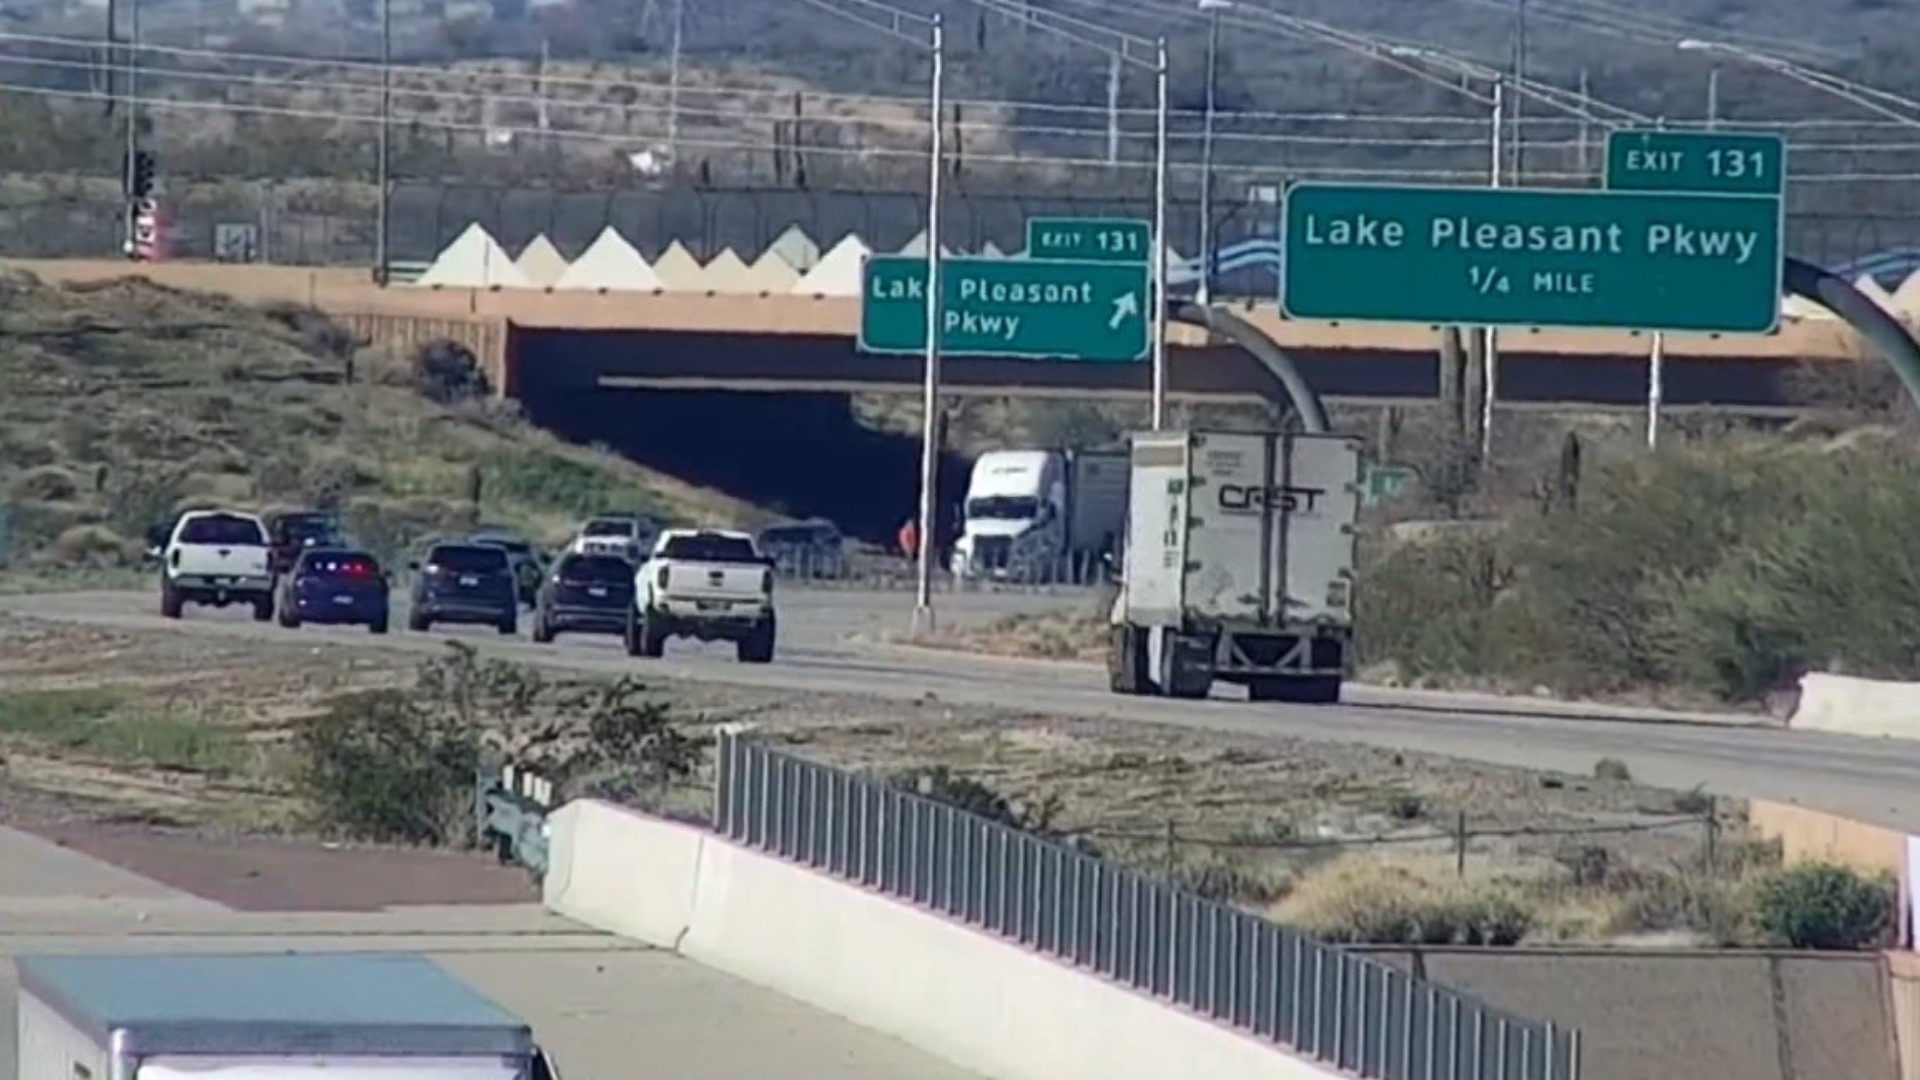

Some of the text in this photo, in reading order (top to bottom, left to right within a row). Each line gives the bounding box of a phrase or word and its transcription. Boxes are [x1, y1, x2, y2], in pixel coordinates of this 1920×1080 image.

[1625, 149, 1765, 178] EXIT 131
[1096, 230, 1137, 252] 131
[1305, 214, 1758, 263] Lake Pleasant Pkwy
[871, 275, 1092, 304] Lak Pleasant
[1469, 266, 1595, 294] 1/4 MILE
[944, 310, 1020, 340] Pkwy
